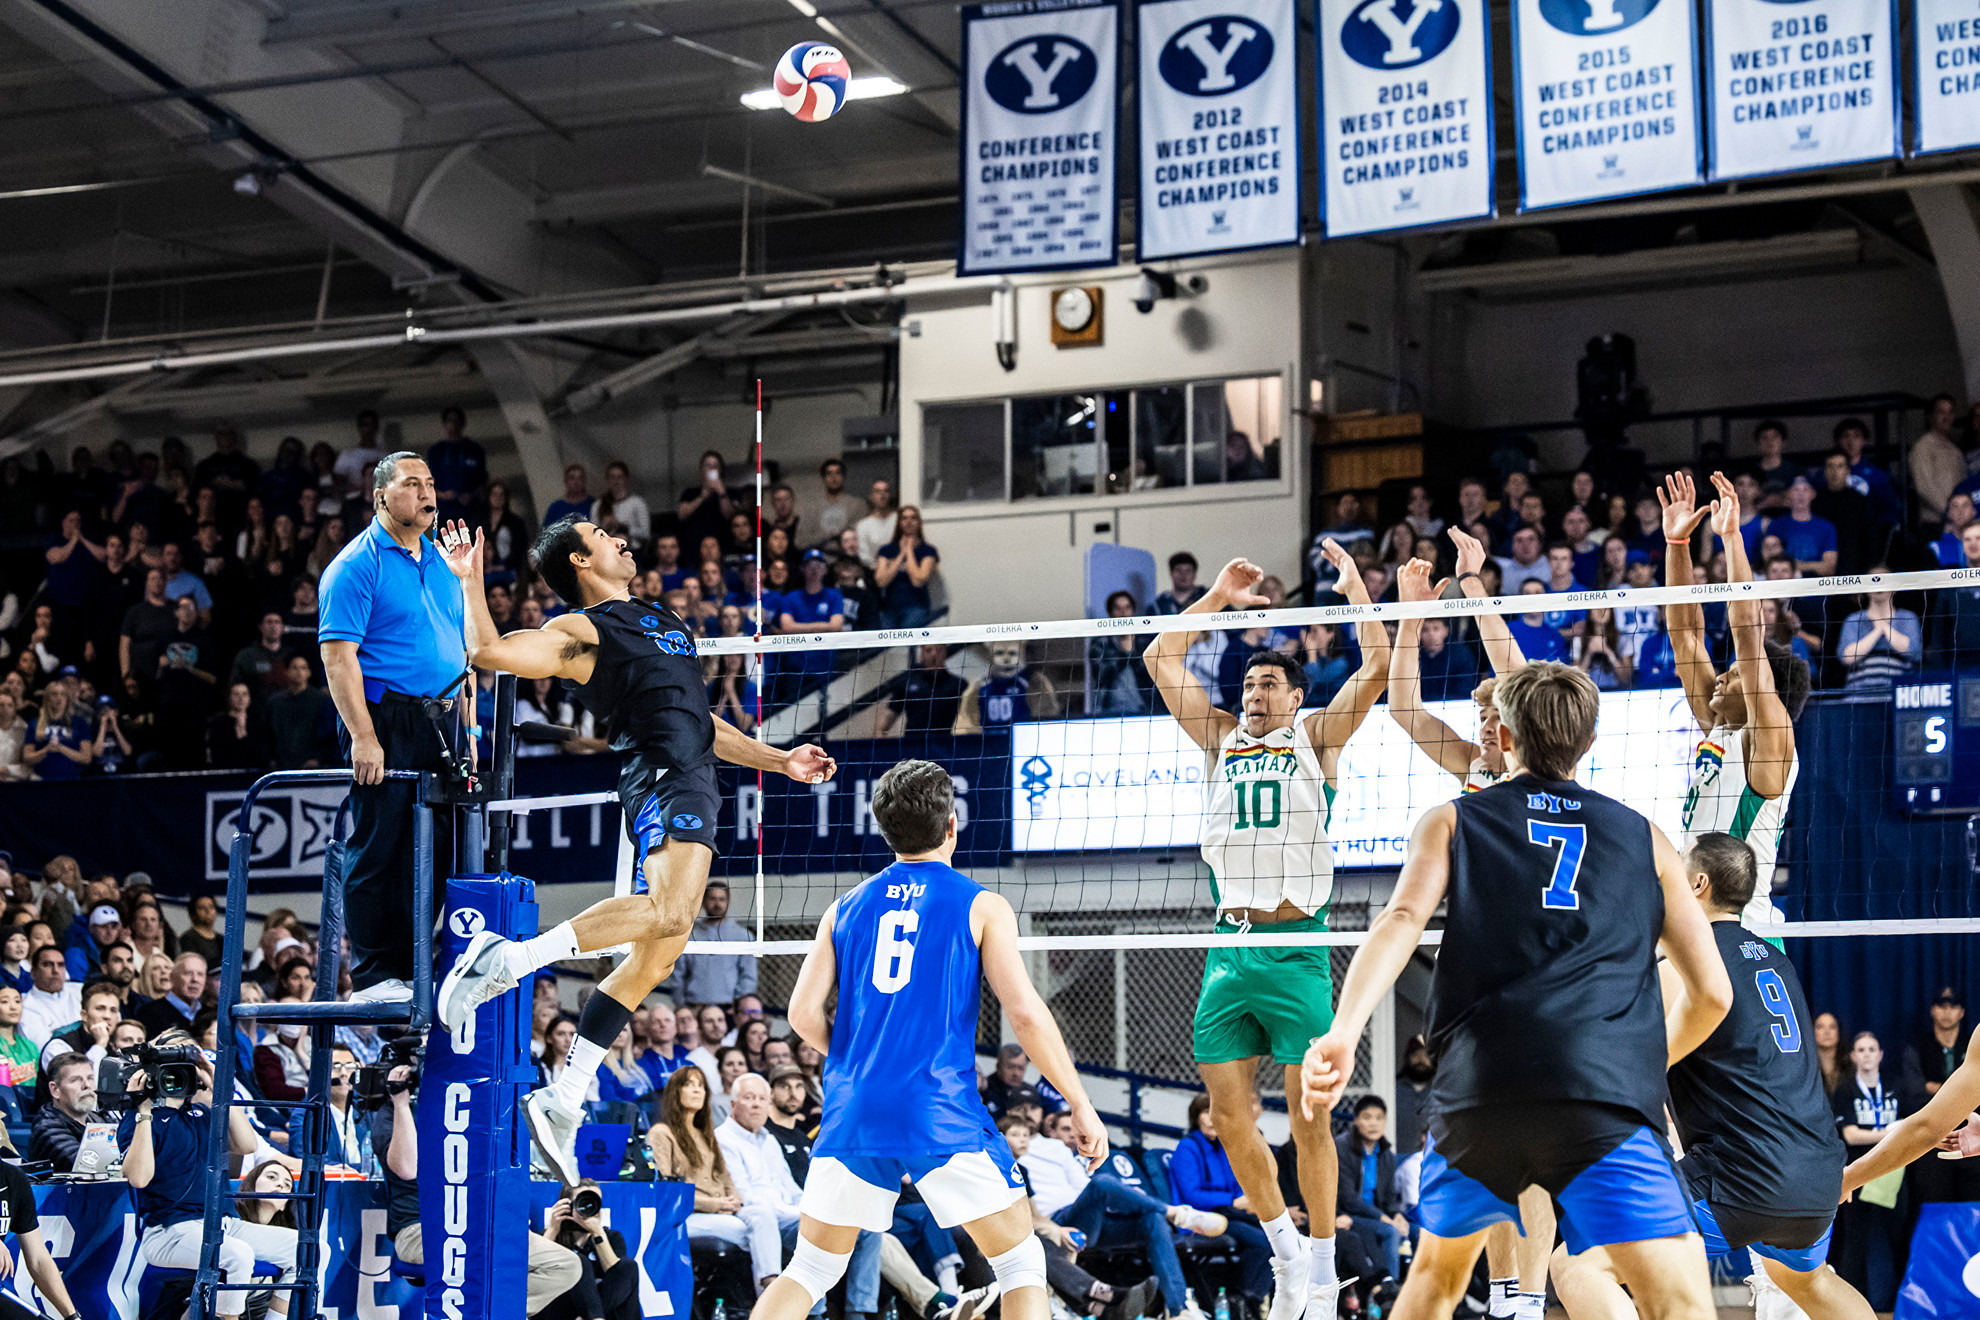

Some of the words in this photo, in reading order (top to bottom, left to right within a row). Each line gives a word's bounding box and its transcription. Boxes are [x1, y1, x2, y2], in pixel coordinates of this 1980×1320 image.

[1771, 14, 1828, 40] 2016
[1936, 18, 1980, 42] WES
[1176, 21, 1256, 91] Y
[1577, 45, 1631, 72] 2015
[1730, 46, 1791, 71] WEST
[1799, 34, 1874, 62] COAST
[1003, 41, 1081, 109] Y
[1378, 80, 1429, 104] 2014
[1539, 79, 1596, 104] WEST
[1605, 64, 1674, 92] COAST
[1730, 60, 1876, 97] CONFERENCE
[1193, 107, 1242, 130] 2012
[1340, 109, 1394, 135] WEST
[1402, 98, 1468, 125] COAST
[1538, 91, 1676, 129] CONFERENCE
[1733, 88, 1874, 124] CHAMPIONS
[979, 131, 1102, 160] CONFERENCE
[1156, 135, 1209, 159] WEST
[1216, 127, 1279, 151] COAST
[1340, 123, 1470, 160] CONFERENCE
[1542, 117, 1675, 154] CHAMPIONS
[981, 157, 1100, 184] CHAMPIONS
[1155, 151, 1281, 184] CONFERENCE
[1343, 149, 1469, 186] CHAMPIONS
[1158, 176, 1279, 208] CHAMPIONS
[1895, 685, 1951, 709] HOME
[1925, 717, 1947, 753] 5
[1060, 766, 1201, 788] LOVELAND
[1234, 780, 1281, 830] 10
[1527, 819, 1587, 910] 7
[886, 883, 926, 901] BYU
[455, 911, 479, 934] Y
[872, 909, 919, 994] 6
[1739, 940, 1769, 960] BYU
[1755, 968, 1801, 1053] 9
[441, 1082, 472, 1320] COUGS
